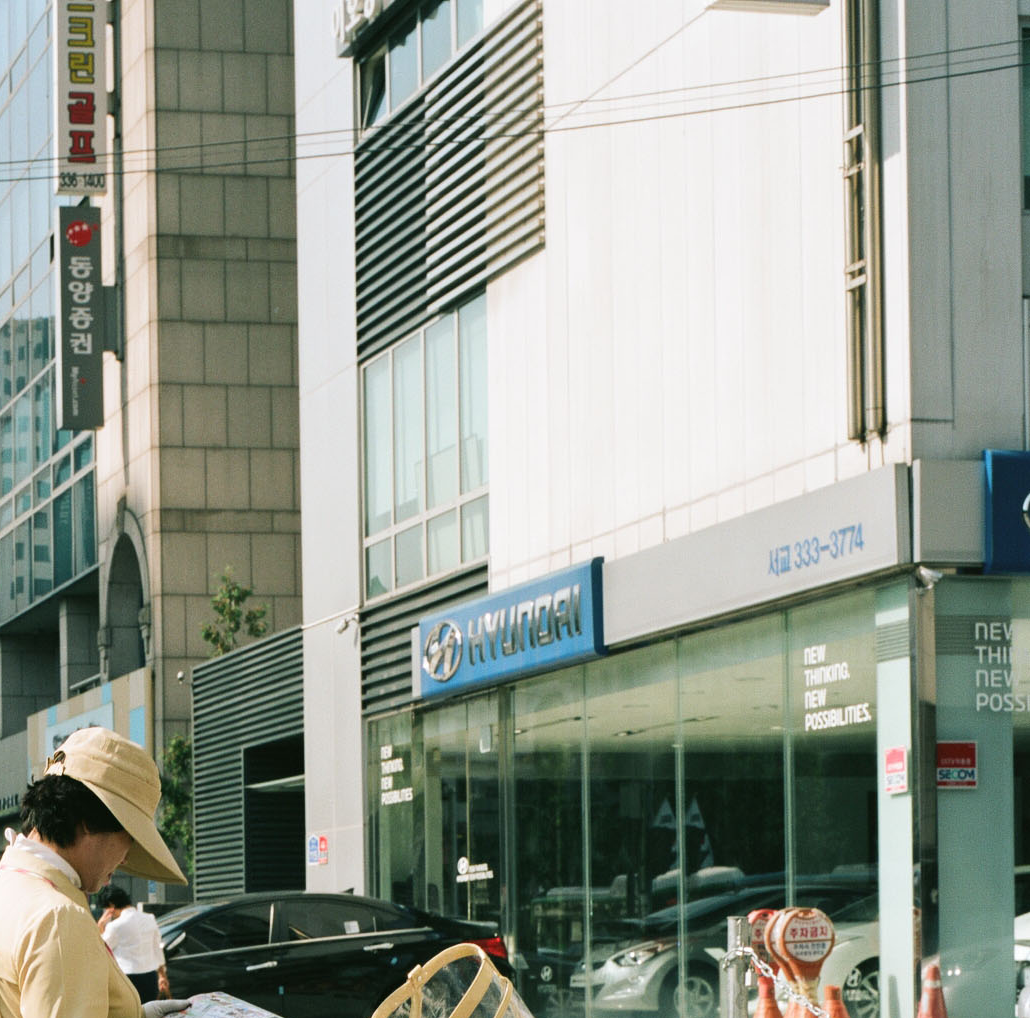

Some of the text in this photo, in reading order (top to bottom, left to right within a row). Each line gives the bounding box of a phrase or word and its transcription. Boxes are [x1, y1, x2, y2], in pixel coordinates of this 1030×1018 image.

[68, 256, 94, 355] 동양증권
[768, 522, 865, 576] 서교 333-3774
[468, 584, 582, 666] HYUNDAI
[804, 644, 826, 666] NEW
[804, 662, 850, 687] THINKING.
[804, 688, 826, 709] NEW
[805, 702, 871, 732] POSSIBILITIES.
[939, 769, 975, 780] SECOM
[790, 926, 828, 939] 주차금지
